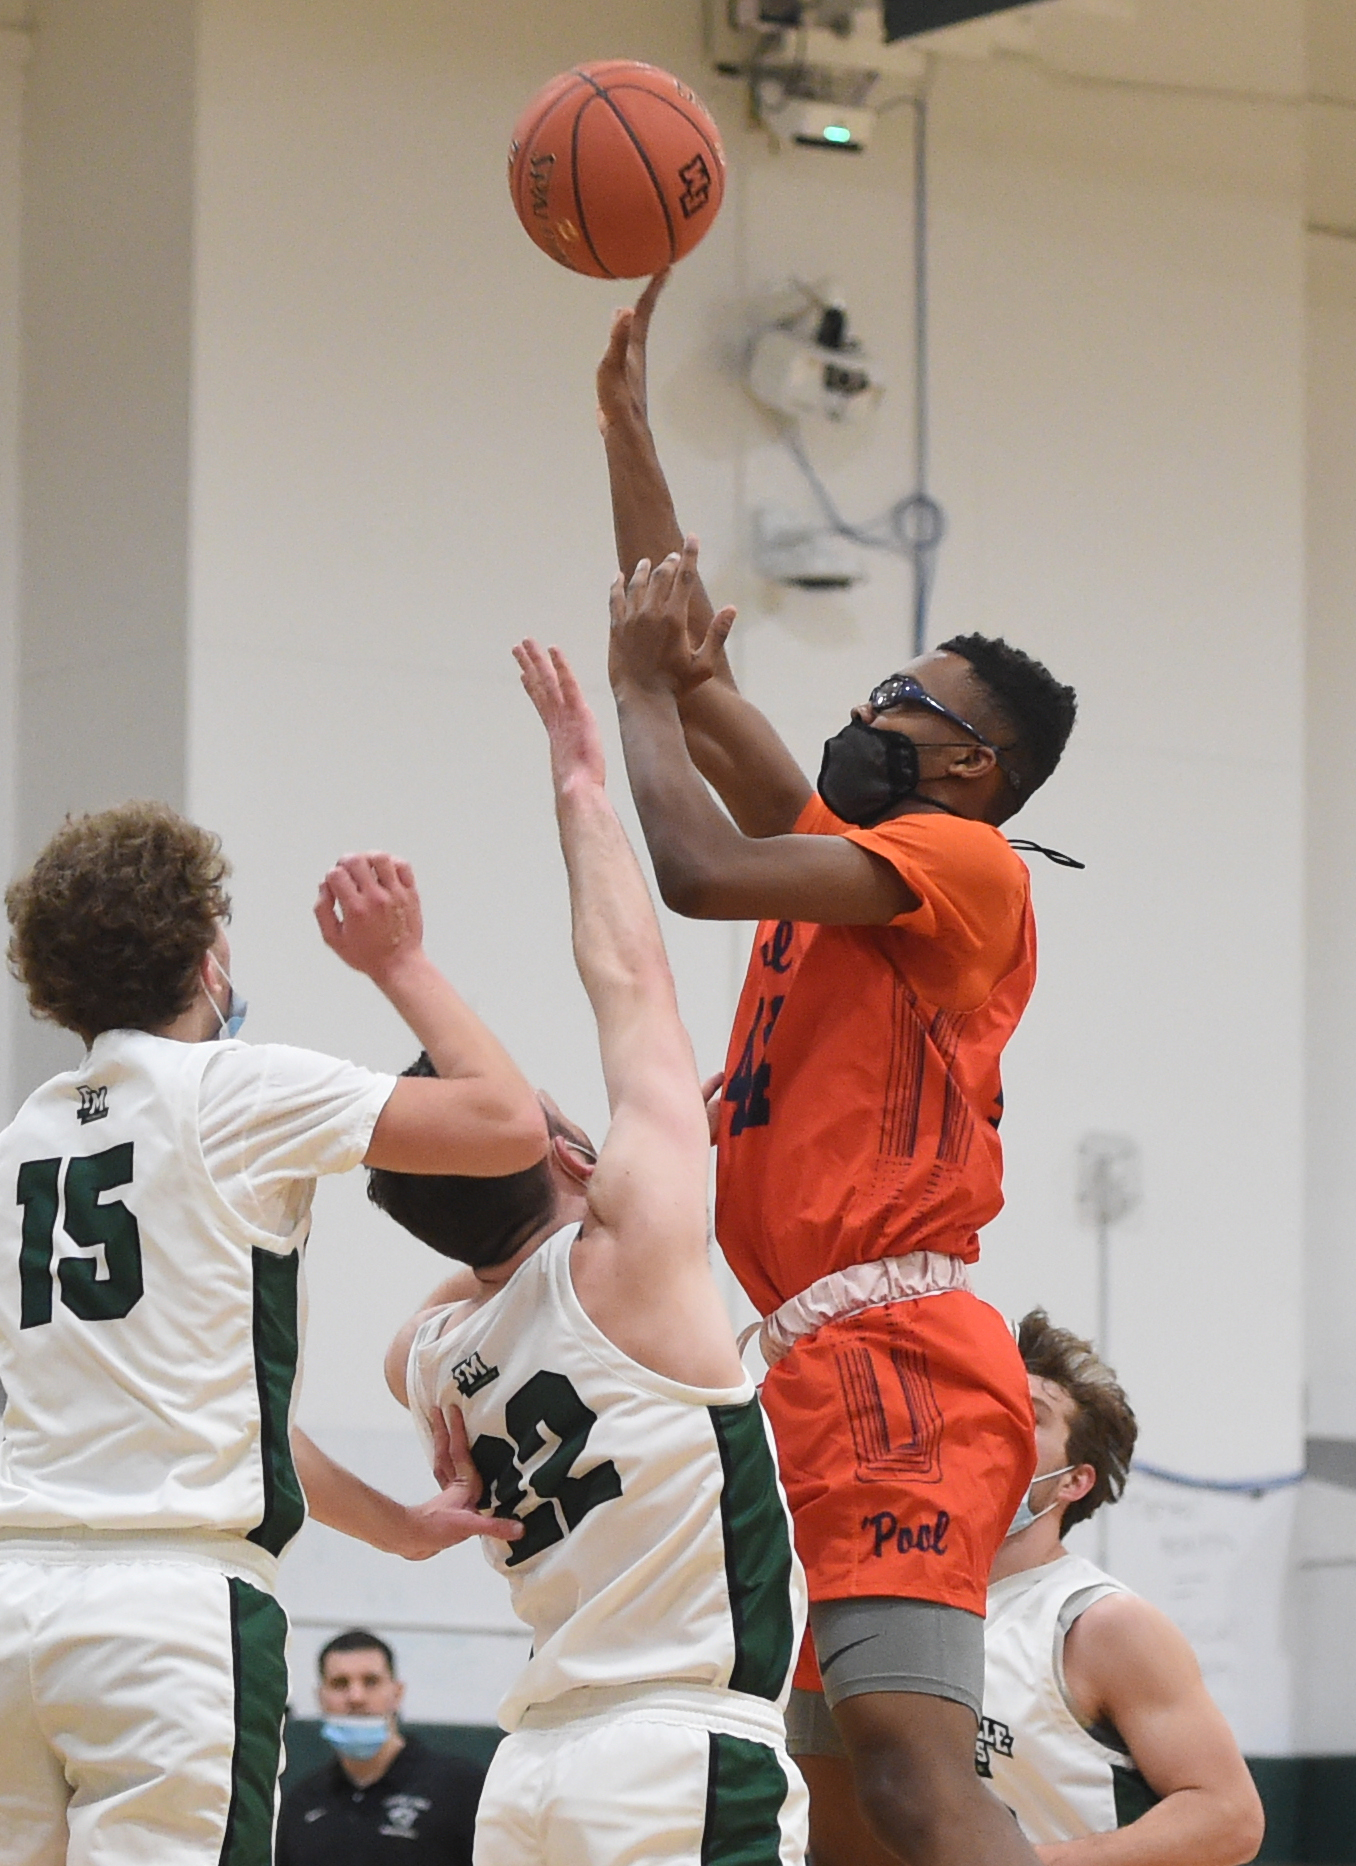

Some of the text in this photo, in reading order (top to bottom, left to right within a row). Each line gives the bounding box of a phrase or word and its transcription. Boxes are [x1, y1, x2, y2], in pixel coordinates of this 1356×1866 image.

[17, 1141, 144, 1330] 15
[471, 1370, 623, 1567] 22
[861, 1511, 950, 1558] Pool
